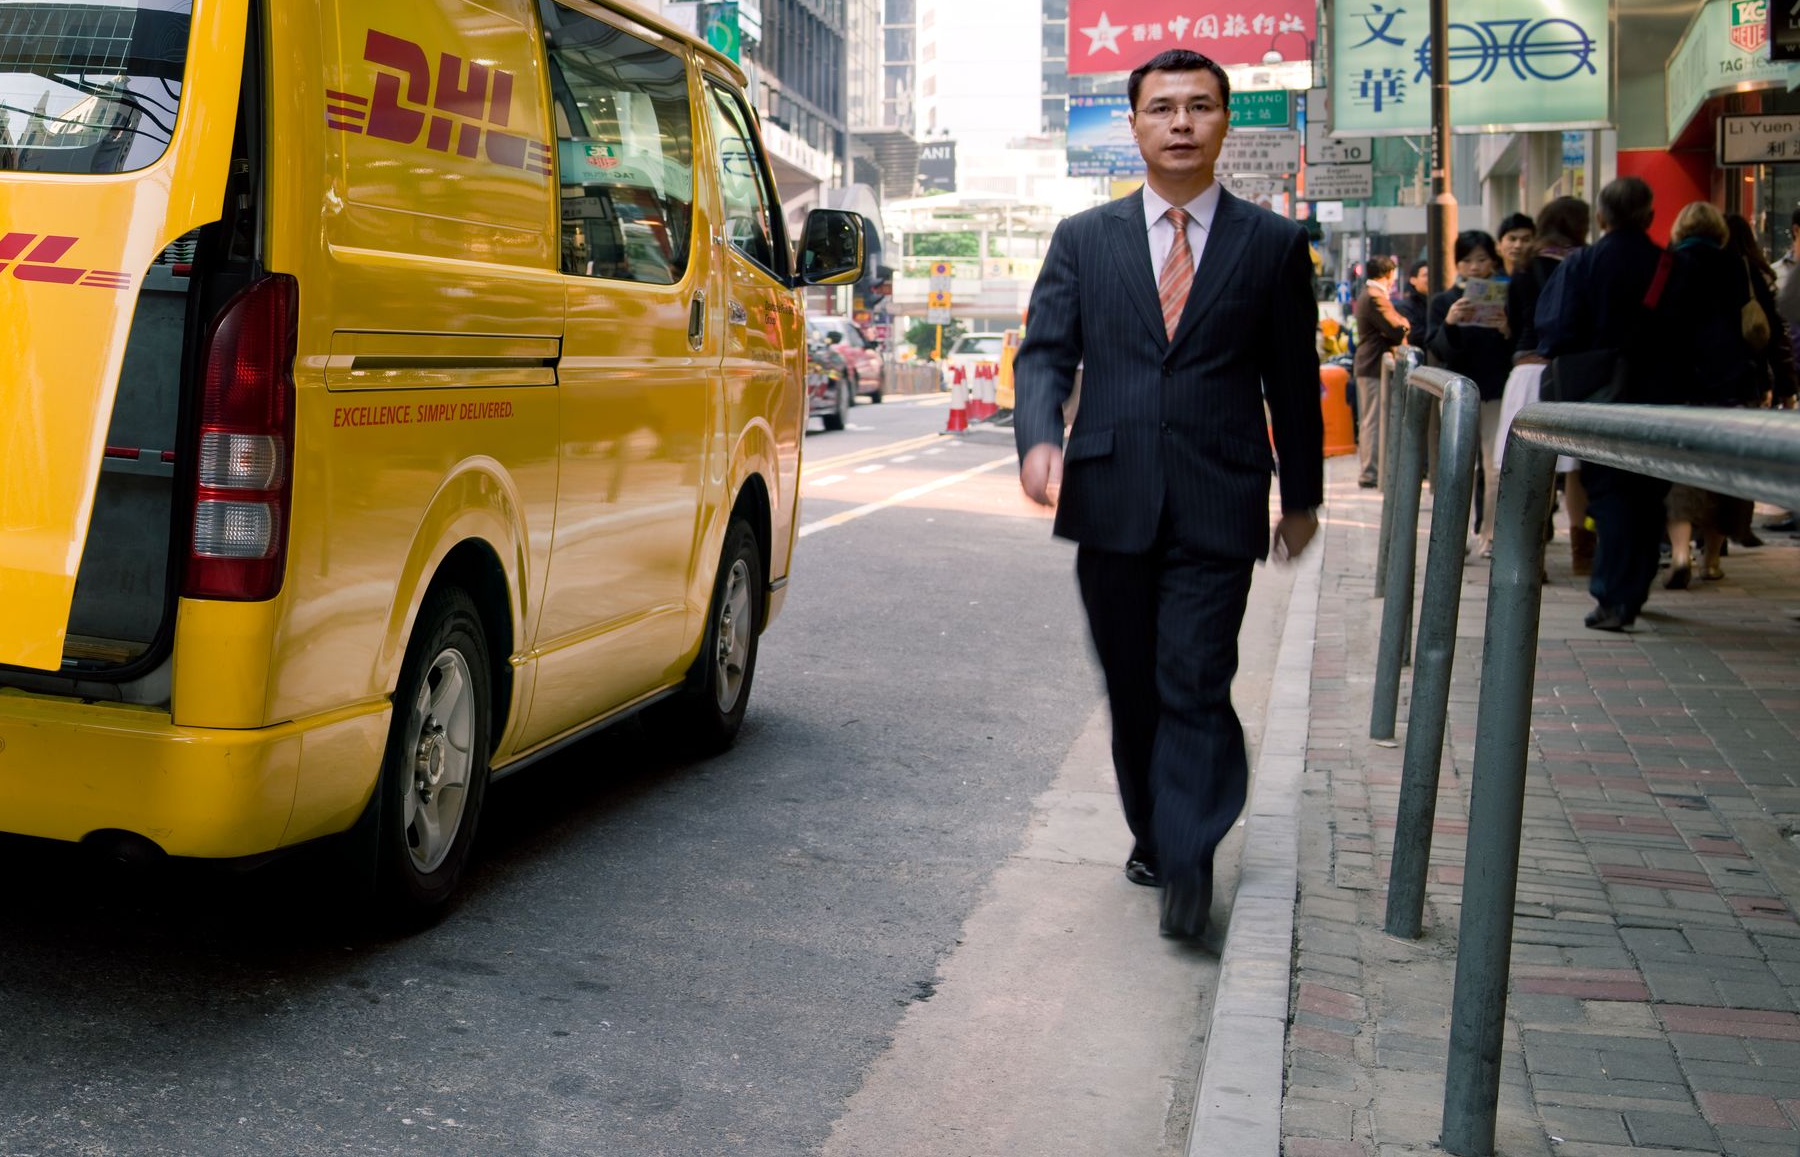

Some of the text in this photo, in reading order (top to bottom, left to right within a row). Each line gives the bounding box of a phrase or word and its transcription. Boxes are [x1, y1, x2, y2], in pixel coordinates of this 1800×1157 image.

[1732, 25, 1767, 49] HEUE
[1349, 2, 1407, 113] 文華
[363, 28, 528, 170] DHL
[1243, 95, 1283, 105] STAND
[1729, 117, 1793, 135] Li Yuen
[1343, 147, 1362, 160] 10
[333, 401, 515, 428] EXCELLENCE. SIMPLY DELIVERED.
